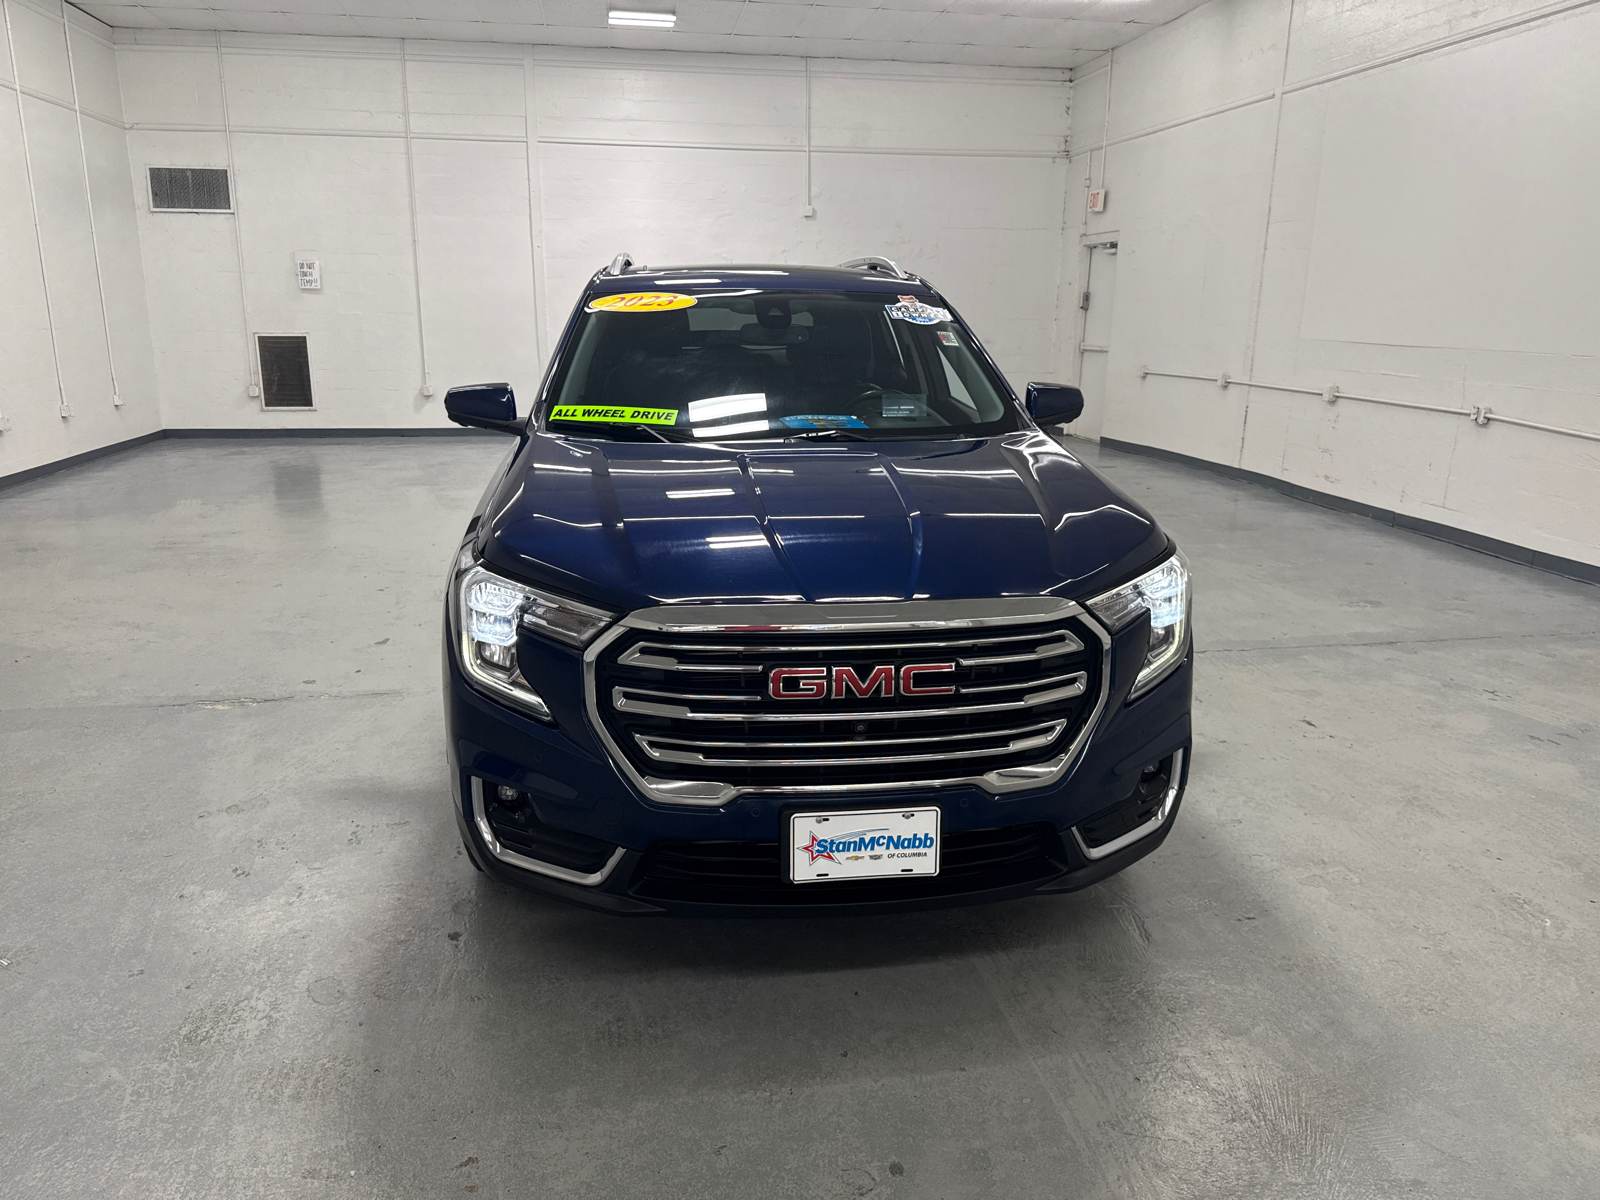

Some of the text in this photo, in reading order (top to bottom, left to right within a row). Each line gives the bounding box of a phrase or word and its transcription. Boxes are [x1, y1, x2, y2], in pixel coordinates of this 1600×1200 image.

[1089, 192, 1100, 209] EXIT
[607, 295, 679, 308] 2023
[553, 408, 675, 420] ALL WHEEL DRIVE
[768, 662, 955, 699] GMC
